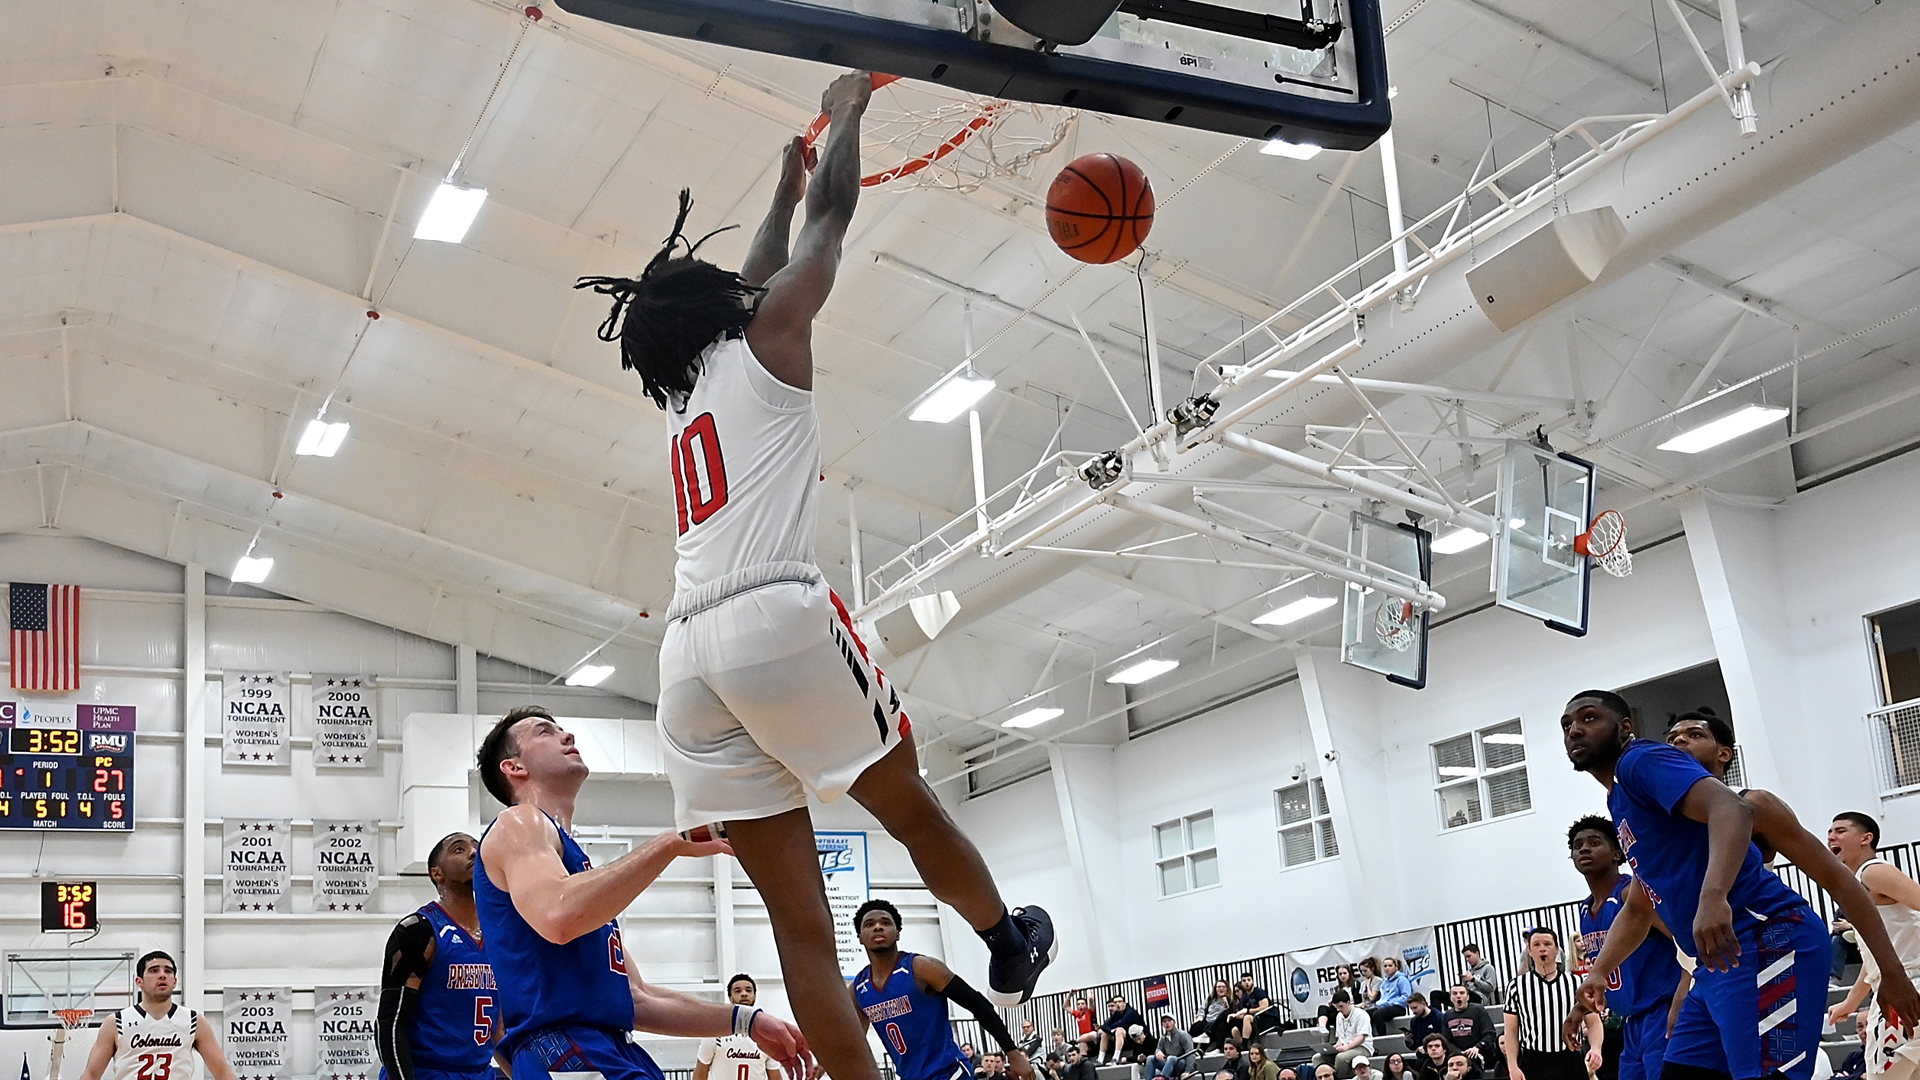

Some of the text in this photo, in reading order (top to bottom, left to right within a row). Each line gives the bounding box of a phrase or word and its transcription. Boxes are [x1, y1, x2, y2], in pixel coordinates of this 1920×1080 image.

[671, 411, 729, 537] 10
[241, 689, 272, 698] 1999
[328, 692, 360, 701] 2000
[230, 702, 284, 715] NCAA
[318, 705, 371, 718] NCAA
[34, 714, 72, 724] PEOPLES
[227, 715, 286, 723] TOURNAMENT
[316, 718, 373, 726] TOURNAMENT
[236, 730, 278, 738] WOMEN'S
[30, 730, 78, 753] 3:52
[90, 735, 126, 747] RMU
[233, 738, 281, 746] VOLLEYBALL
[33, 761, 58, 769] PERIOD
[95, 757, 113, 767] PC
[46, 772, 51, 788] 1
[94, 770, 123, 792] 27
[52, 792, 69, 800] FOUL
[80, 802, 91, 818] 4
[111, 801, 123, 819] 5
[33, 820, 57, 828] MATCH
[241, 837, 272, 846] 2001
[330, 838, 362, 848] 2002
[230, 851, 284, 864] NCAA
[320, 852, 372, 865] NCAA
[227, 864, 287, 872] TOURNAMENT
[236, 879, 279, 887] WOMEN'S
[325, 880, 367, 888] WOMEN'S
[58, 885, 92, 902] 3:52
[64, 901, 85, 928] 16
[241, 1007, 274, 1016] 2003
[333, 1006, 363, 1016] 2015
[474, 996, 493, 1046] 5
[230, 1021, 286, 1034] NCAA
[322, 1021, 374, 1033] NCAA
[131, 1034, 182, 1048] Colonials
[886, 1022, 907, 1055] 0
[236, 1050, 280, 1058] WOMEN'S
[327, 1049, 370, 1057] WOMEN'S
[727, 1048, 760, 1059] Colonials
[137, 1053, 172, 1080] 23
